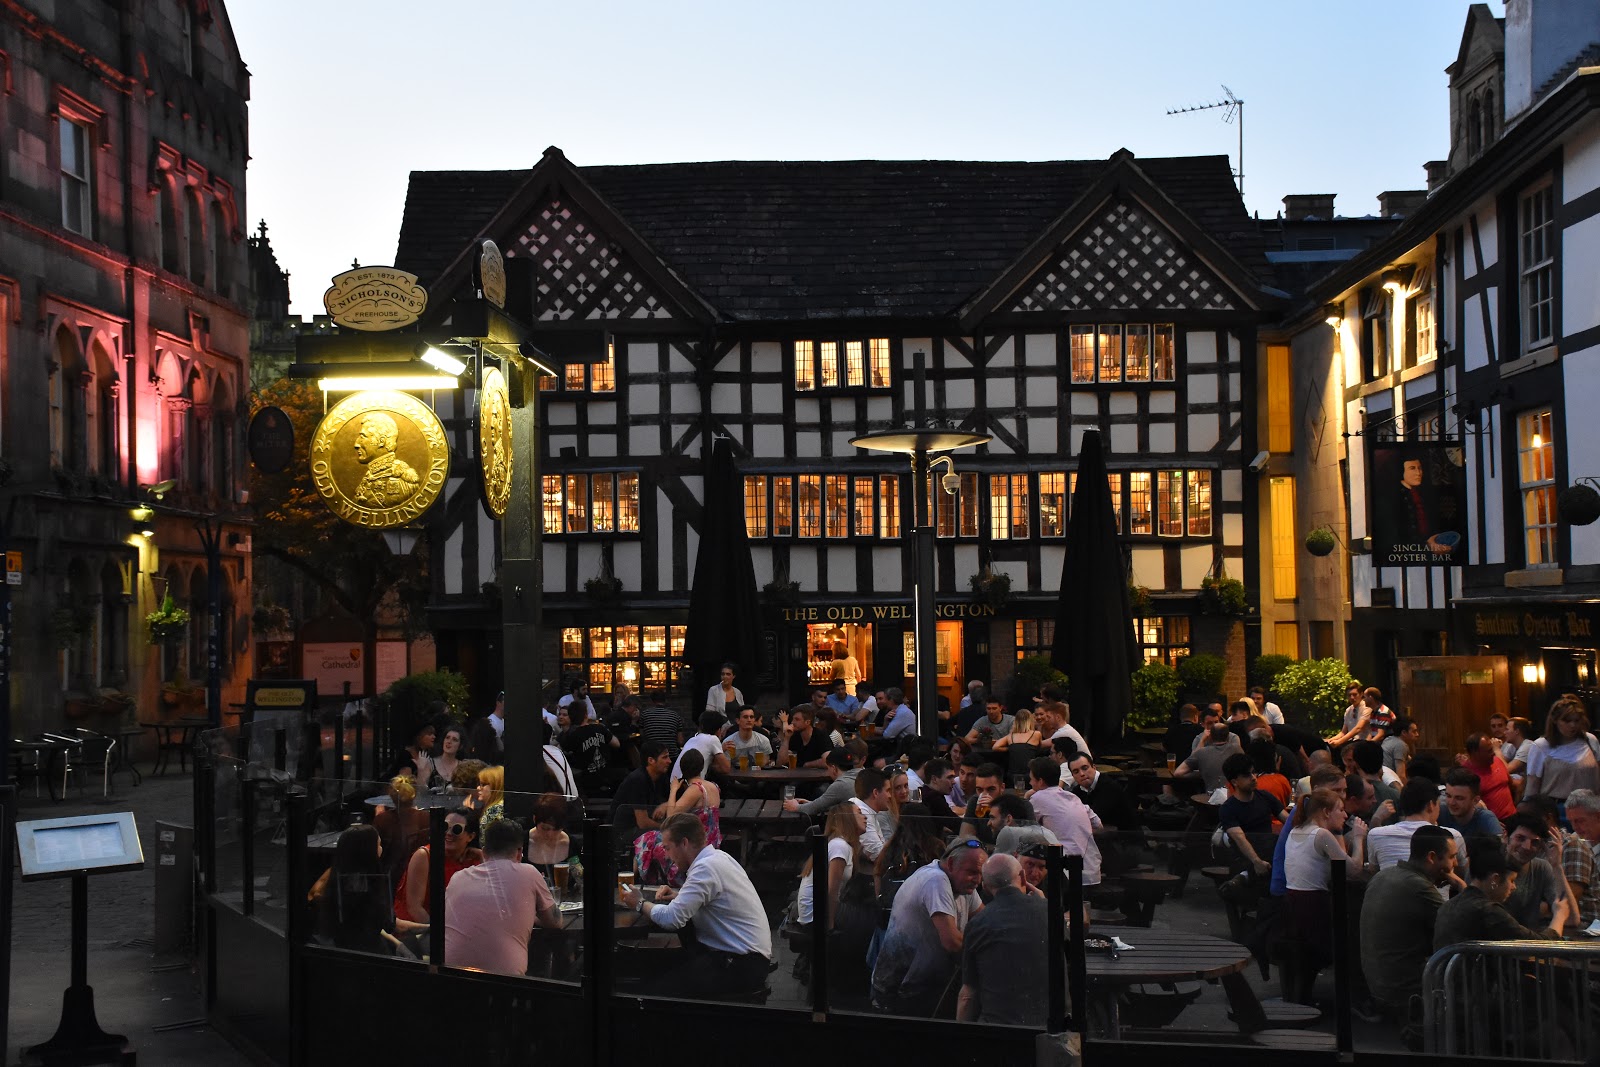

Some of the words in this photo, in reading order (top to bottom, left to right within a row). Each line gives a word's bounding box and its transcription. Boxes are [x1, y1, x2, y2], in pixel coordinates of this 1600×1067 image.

[357, 272, 374, 281] EST.
[377, 272, 396, 280] 1873
[338, 288, 416, 309] NICHOLSON'S
[313, 460, 336, 498] OLD
[340, 457, 447, 527] WELLINGTON
[1388, 553, 1428, 562] OYSTER
[1432, 553, 1452, 561] BAR
[782, 607, 819, 621] THE
[826, 606, 865, 621] OLD
[872, 603, 996, 620] WELNGTON
[321, 660, 361, 669] Cathedral
